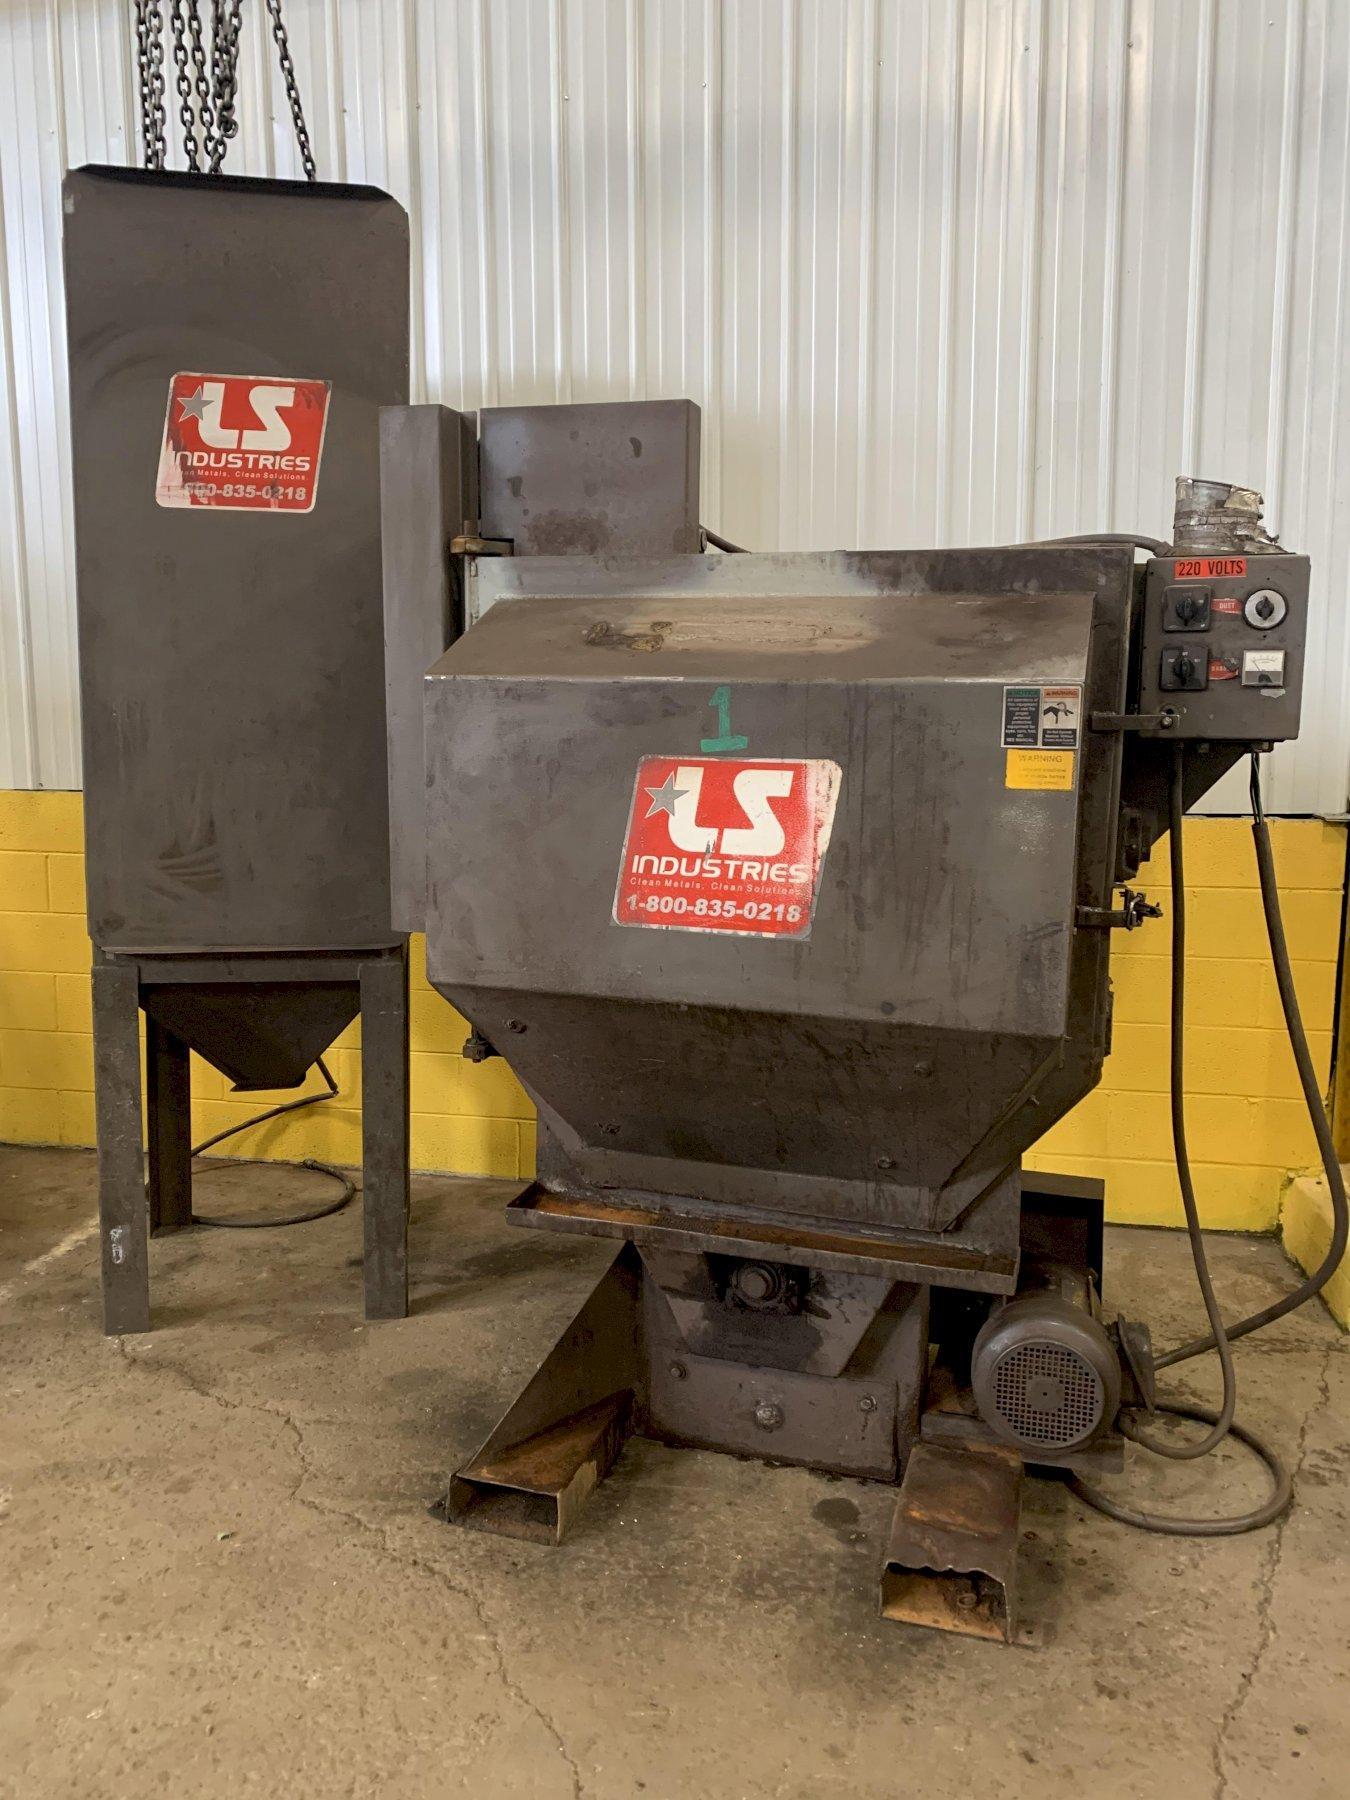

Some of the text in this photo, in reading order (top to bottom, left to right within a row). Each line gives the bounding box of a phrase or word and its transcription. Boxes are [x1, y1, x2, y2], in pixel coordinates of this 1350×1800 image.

[197, 382, 296, 451] LS
[1178, 560, 1243, 576] 220 VOLTS
[700, 686, 749, 752] 1
[1018, 754, 1063, 763] WARNING
[667, 766, 795, 857] LS
[631, 854, 810, 883] INDUSTRIES
[629, 877, 661, 887] Clean
[664, 879, 705, 889] Metals.
[711, 881, 743, 892] Clean
[626, 894, 802, 923] 1-800-835-0218
